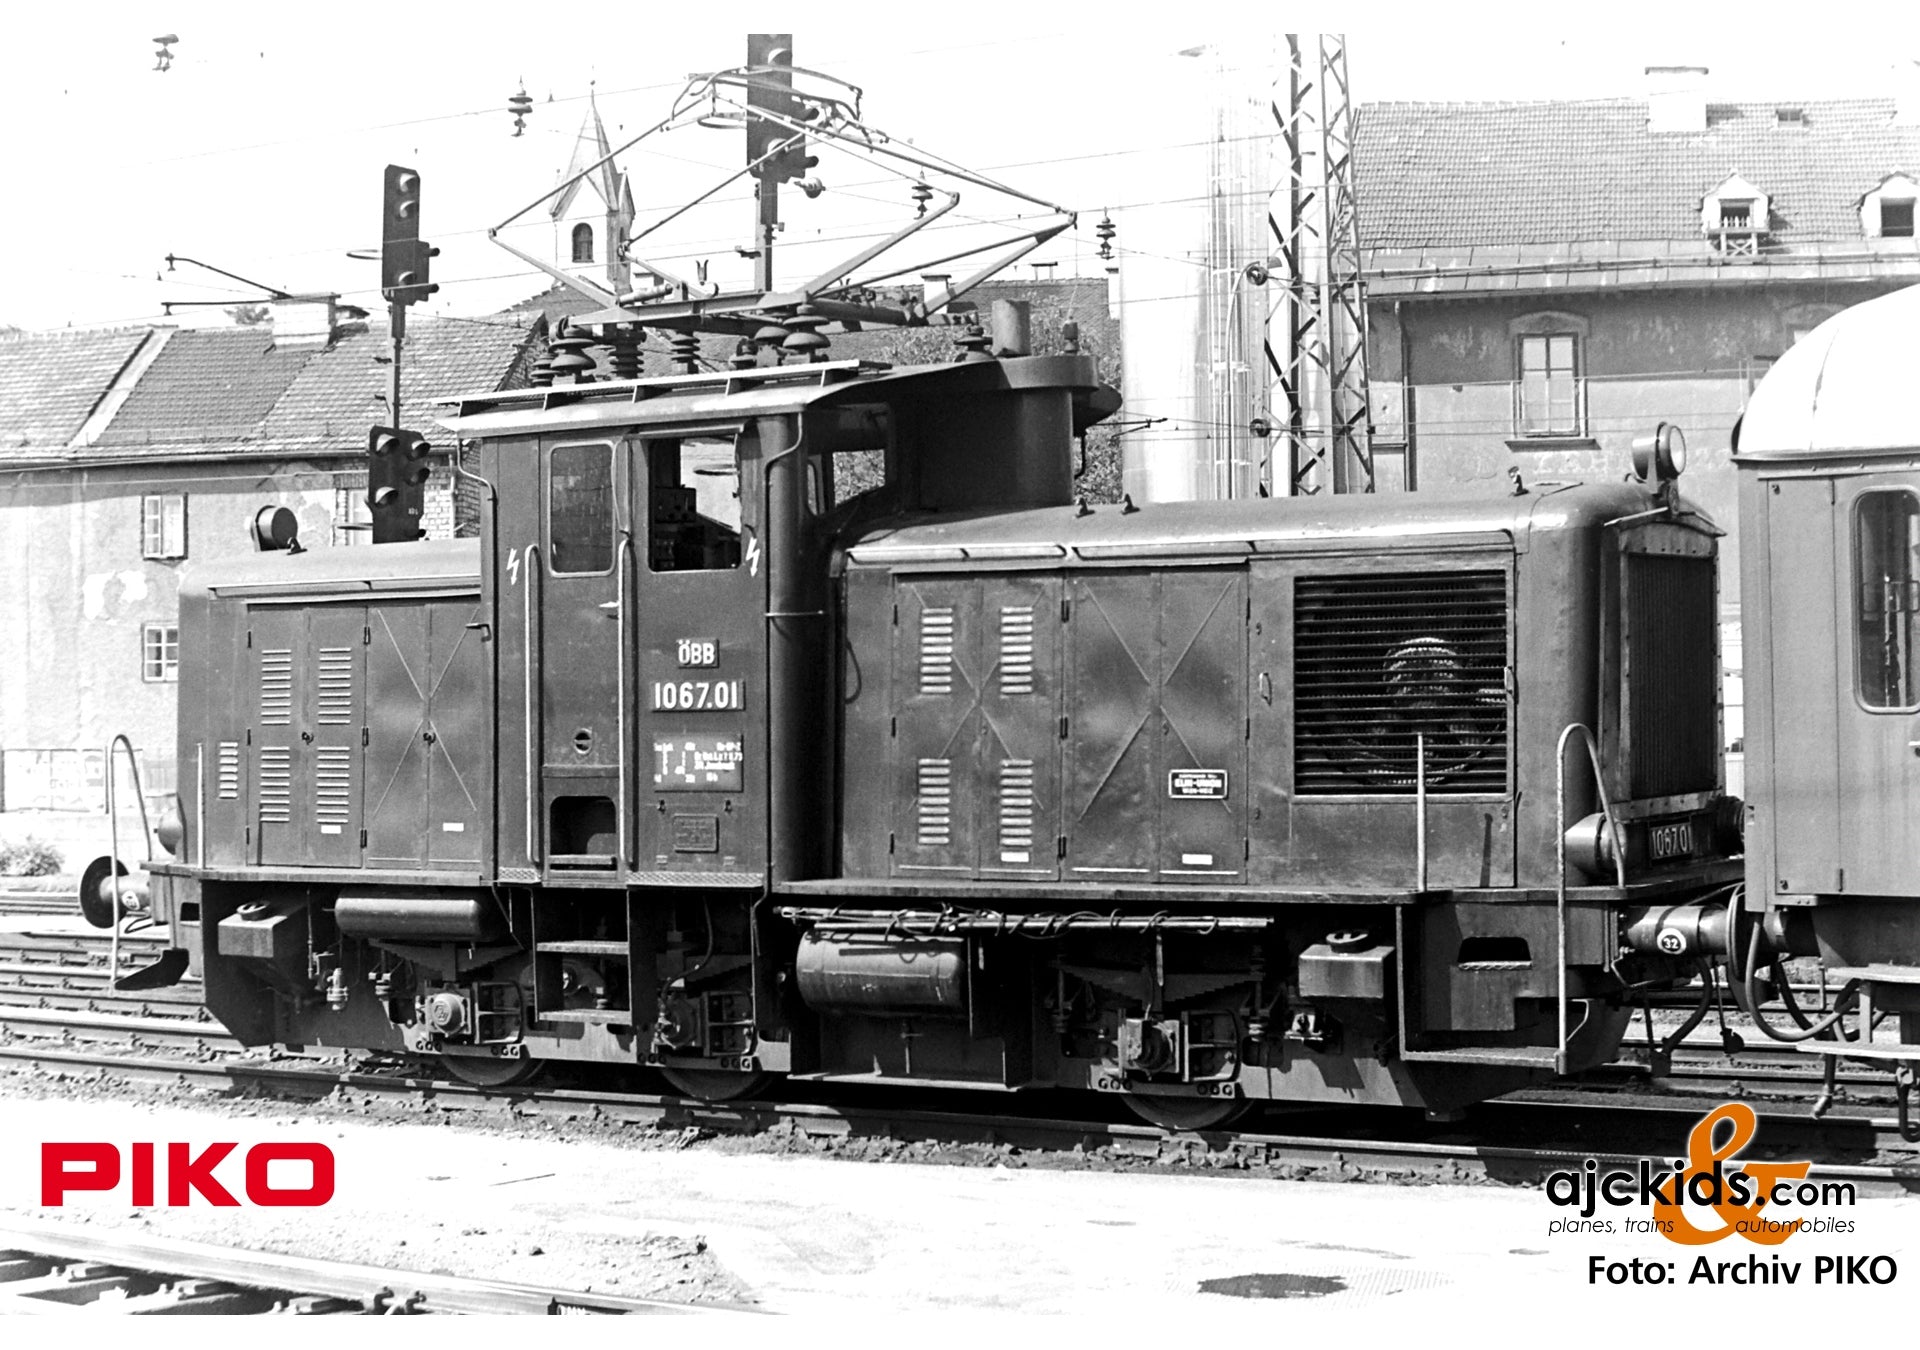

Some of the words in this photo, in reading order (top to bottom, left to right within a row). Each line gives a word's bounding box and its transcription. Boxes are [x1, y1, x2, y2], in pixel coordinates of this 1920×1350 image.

[678, 639, 715, 664] ÖBB
[655, 681, 737, 709] 1067.01
[1662, 937, 1679, 949] 32
